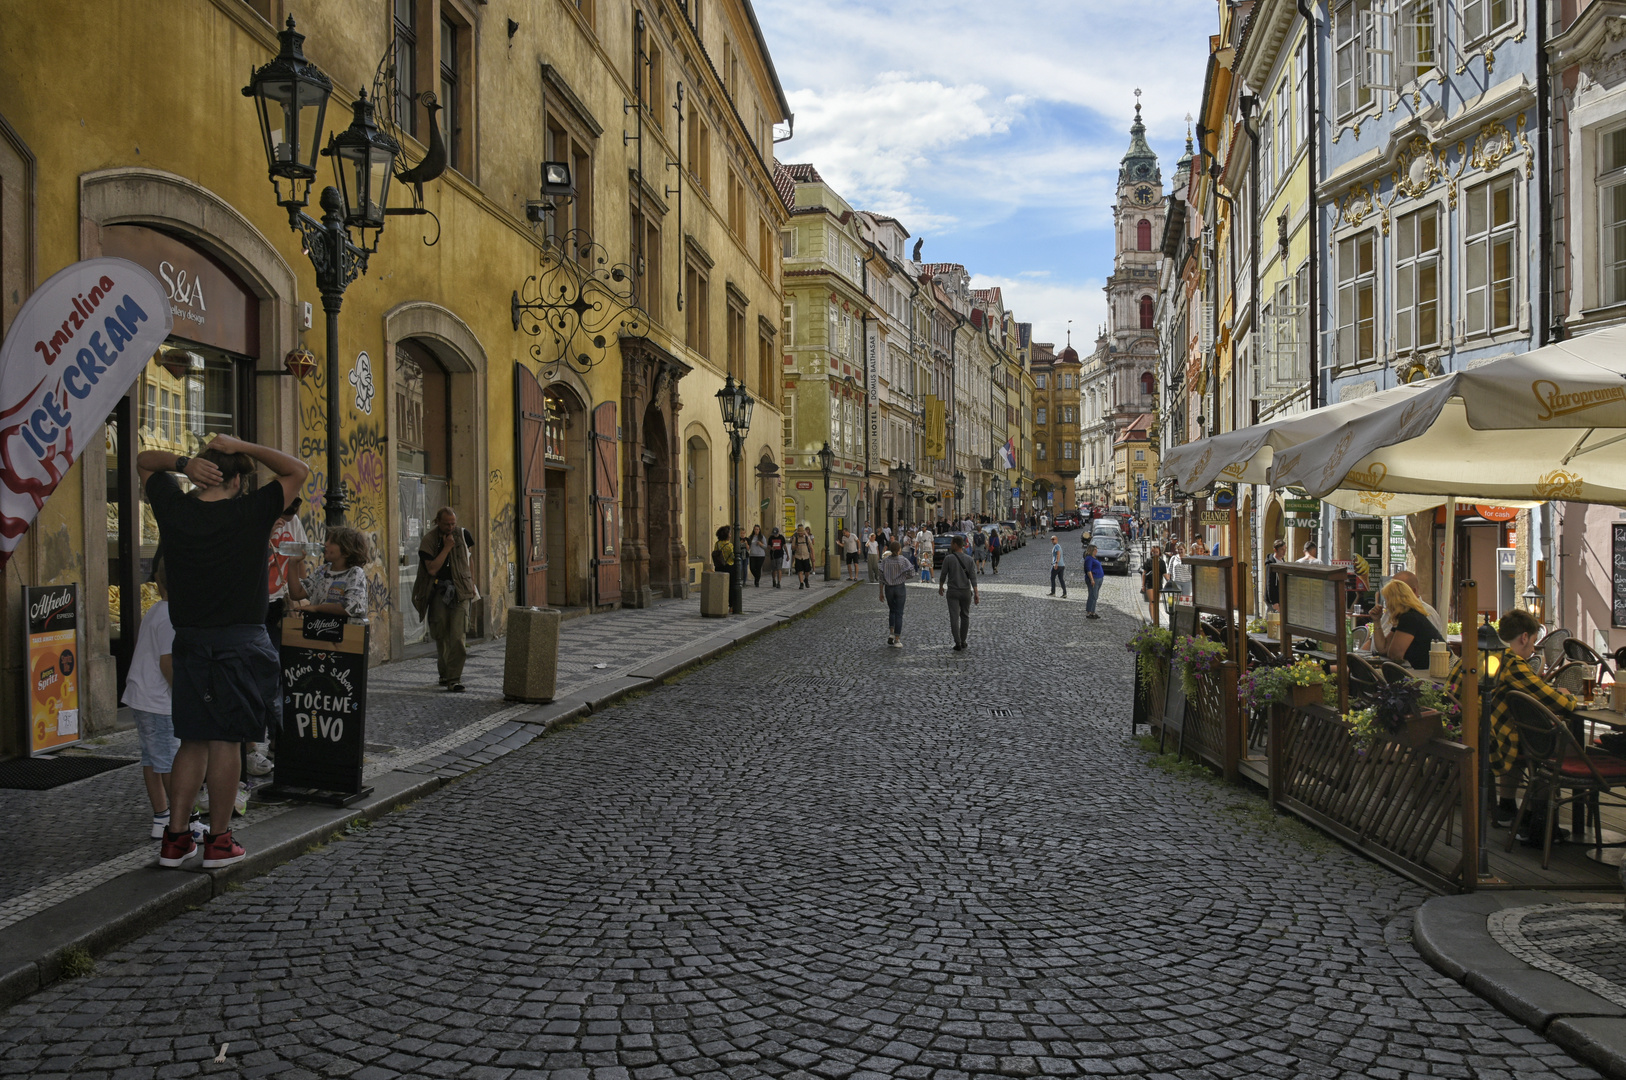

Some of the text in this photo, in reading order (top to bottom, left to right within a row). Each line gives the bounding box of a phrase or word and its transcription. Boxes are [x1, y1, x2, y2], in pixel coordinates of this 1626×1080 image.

[159, 261, 206, 311] S&A
[170, 305, 205, 326] ellery design
[21, 294, 148, 460] ICE CREAM
[1532, 379, 1625, 421] Staropramen
[871, 438, 879, 465] DESIGN
[1200, 510, 1229, 521] CHANGE
[1297, 518, 1317, 528] WC
[1501, 553, 1515, 563] AT
[30, 589, 72, 620] Alfredo
[56, 612, 75, 620] ESPRESSO
[307, 618, 340, 632] Alfredo
[37, 673, 58, 691] Spritz
[284, 663, 314, 688] Káva
[318, 664, 326, 674] s
